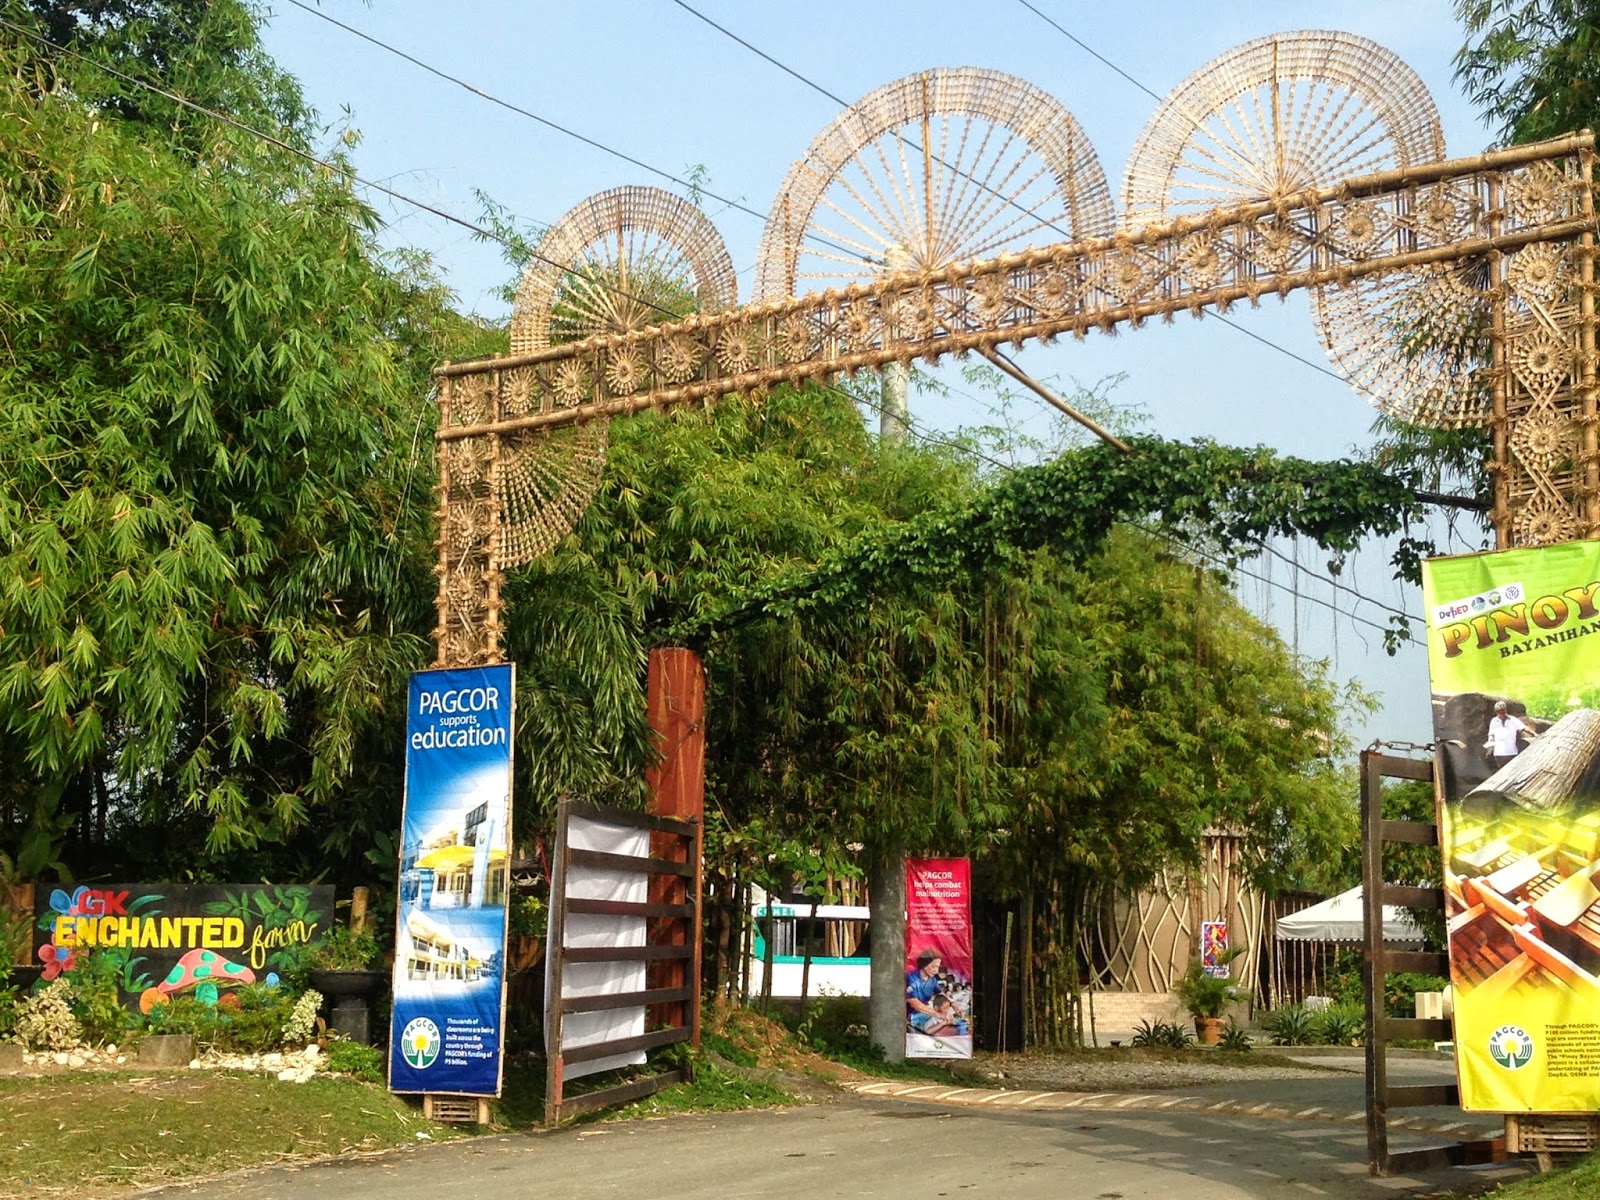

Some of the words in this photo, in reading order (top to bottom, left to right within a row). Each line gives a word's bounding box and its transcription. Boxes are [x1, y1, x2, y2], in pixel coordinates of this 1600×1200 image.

[1438, 581, 1600, 658] PINOY
[1500, 620, 1600, 658] BAYANIHAN
[420, 687, 499, 715] PAGCOR
[440, 714, 477, 728] supports
[411, 723, 506, 750] education
[914, 880, 933, 889] helps
[78, 889, 130, 916] GK
[758, 907, 794, 917] CMET
[55, 916, 244, 948] ENCHANTED
[242, 920, 318, 970] farm
[405, 1020, 438, 1038] PAGCOR
[1491, 1026, 1529, 1042] PAGCOR
